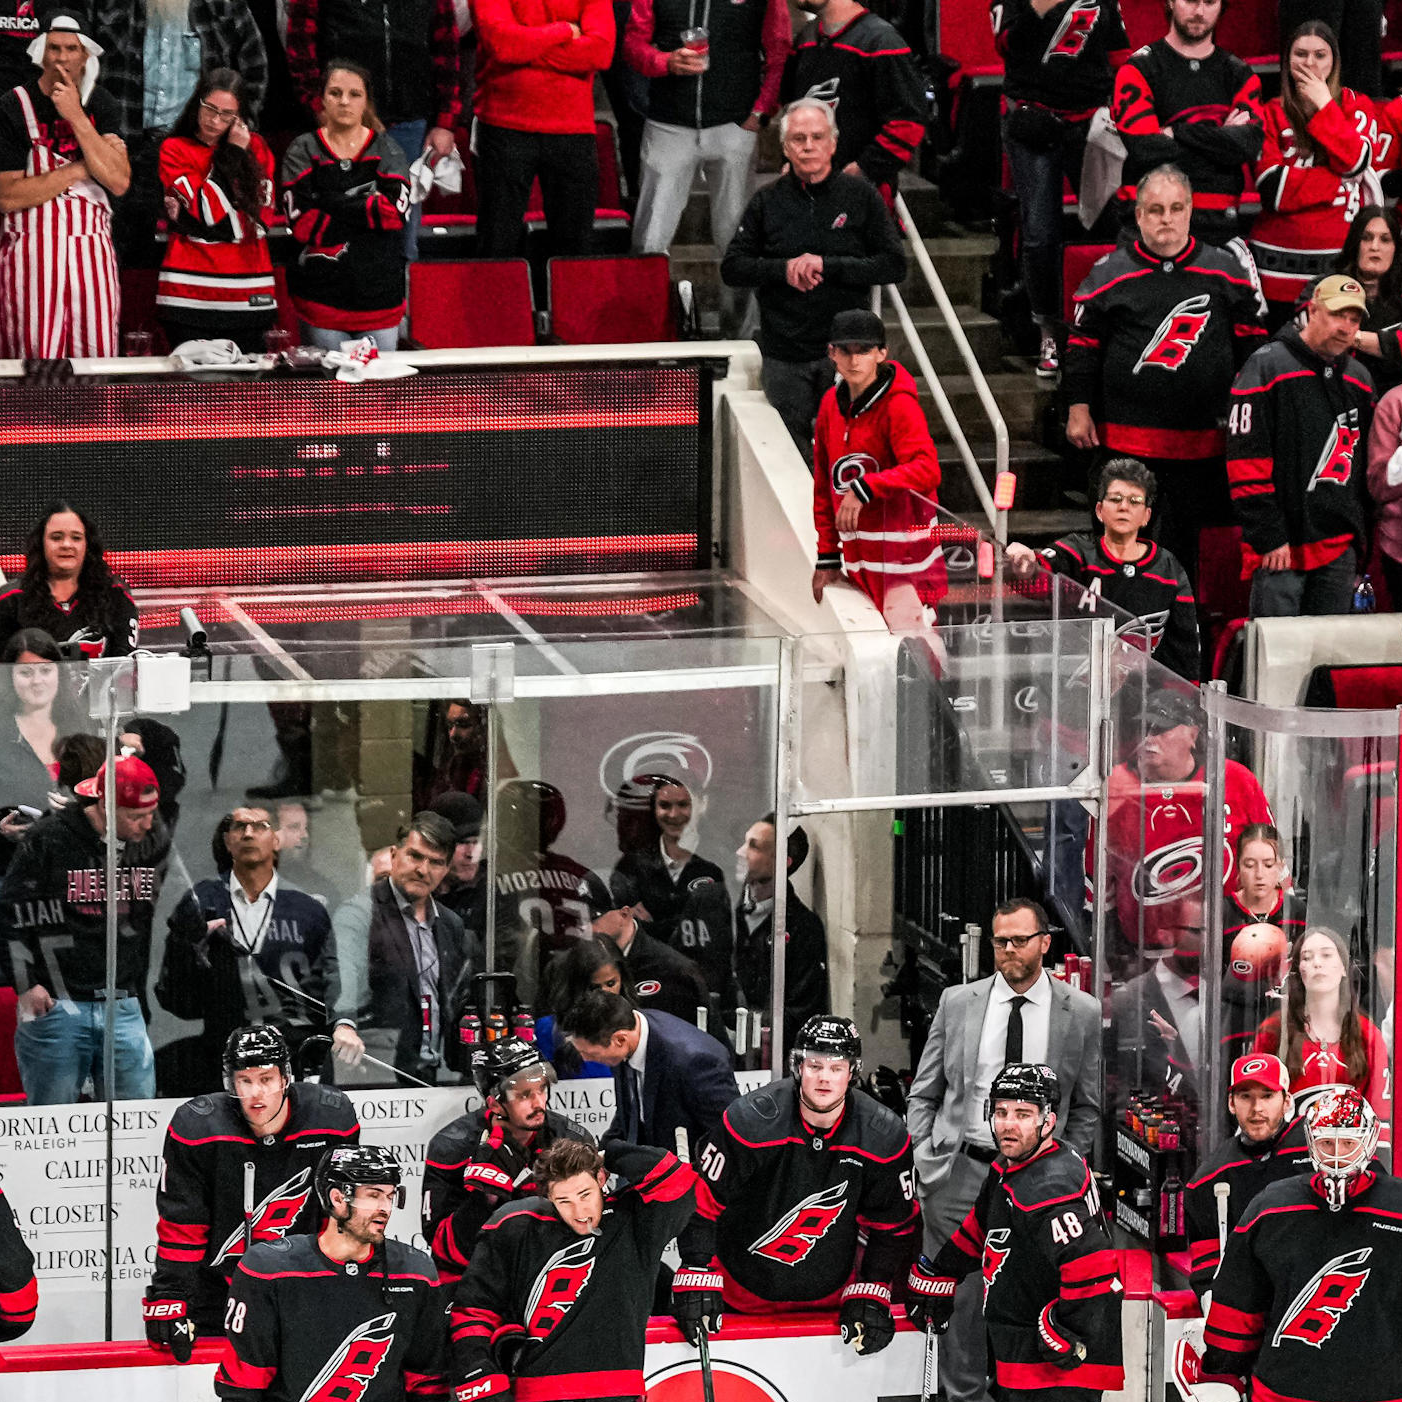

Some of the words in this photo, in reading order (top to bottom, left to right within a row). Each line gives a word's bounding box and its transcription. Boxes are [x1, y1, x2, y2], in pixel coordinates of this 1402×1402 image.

[1229, 403, 1253, 436] 48
[66, 866, 156, 903] HURRCANES
[68, 1110, 159, 1134] CLOSETS
[567, 1111, 608, 1123] LEIGH
[14, 1138, 77, 1151] RALEIGH
[45, 1155, 162, 1180] CALIFRNI
[701, 1142, 726, 1182] 50
[1324, 1177, 1346, 1206] 31
[29, 1203, 120, 1226] CLOSETS
[1372, 1221, 1402, 1233] NUCOR
[1050, 1211, 1084, 1246] 48
[35, 1245, 136, 1271] LIFORIA
[142, 1301, 184, 1319] UER
[224, 1296, 248, 1335] 28
